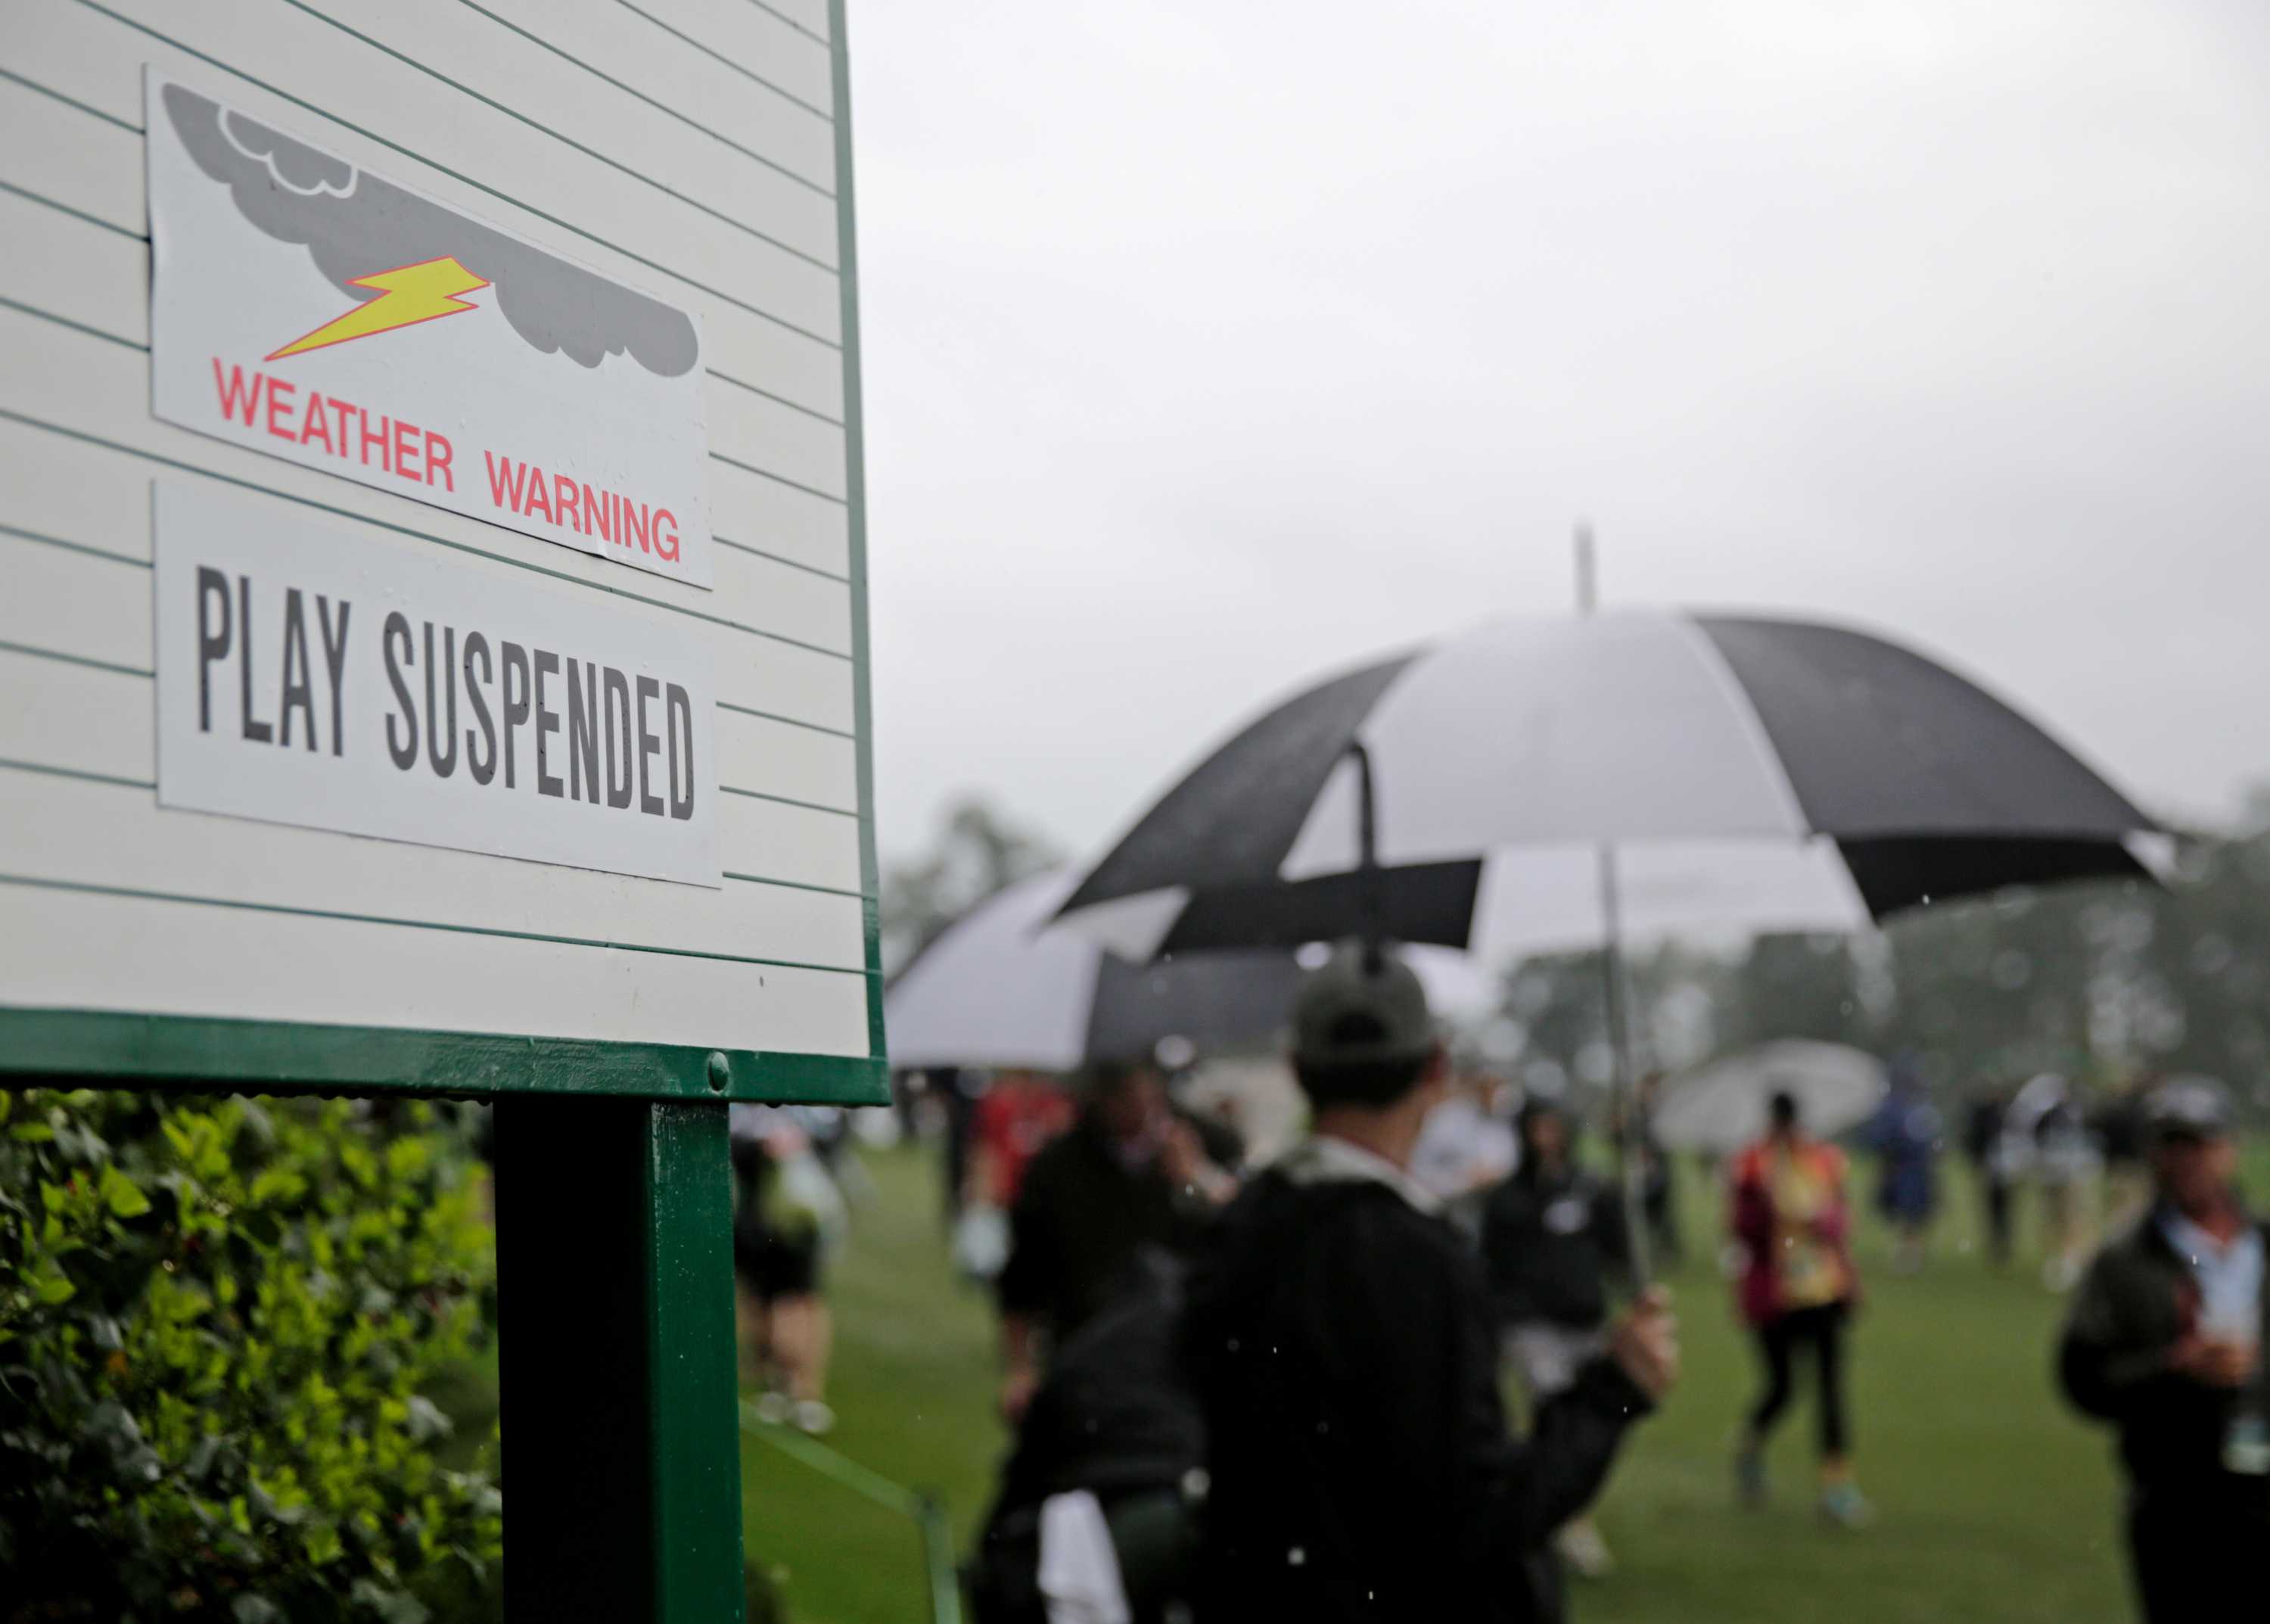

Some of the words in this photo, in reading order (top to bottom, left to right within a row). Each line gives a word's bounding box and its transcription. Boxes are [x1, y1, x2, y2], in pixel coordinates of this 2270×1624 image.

[212, 357, 455, 493] WEATHER
[484, 450, 681, 564] WARNING
[197, 564, 351, 758] PLAY
[382, 610, 695, 822] SUSPENDED
